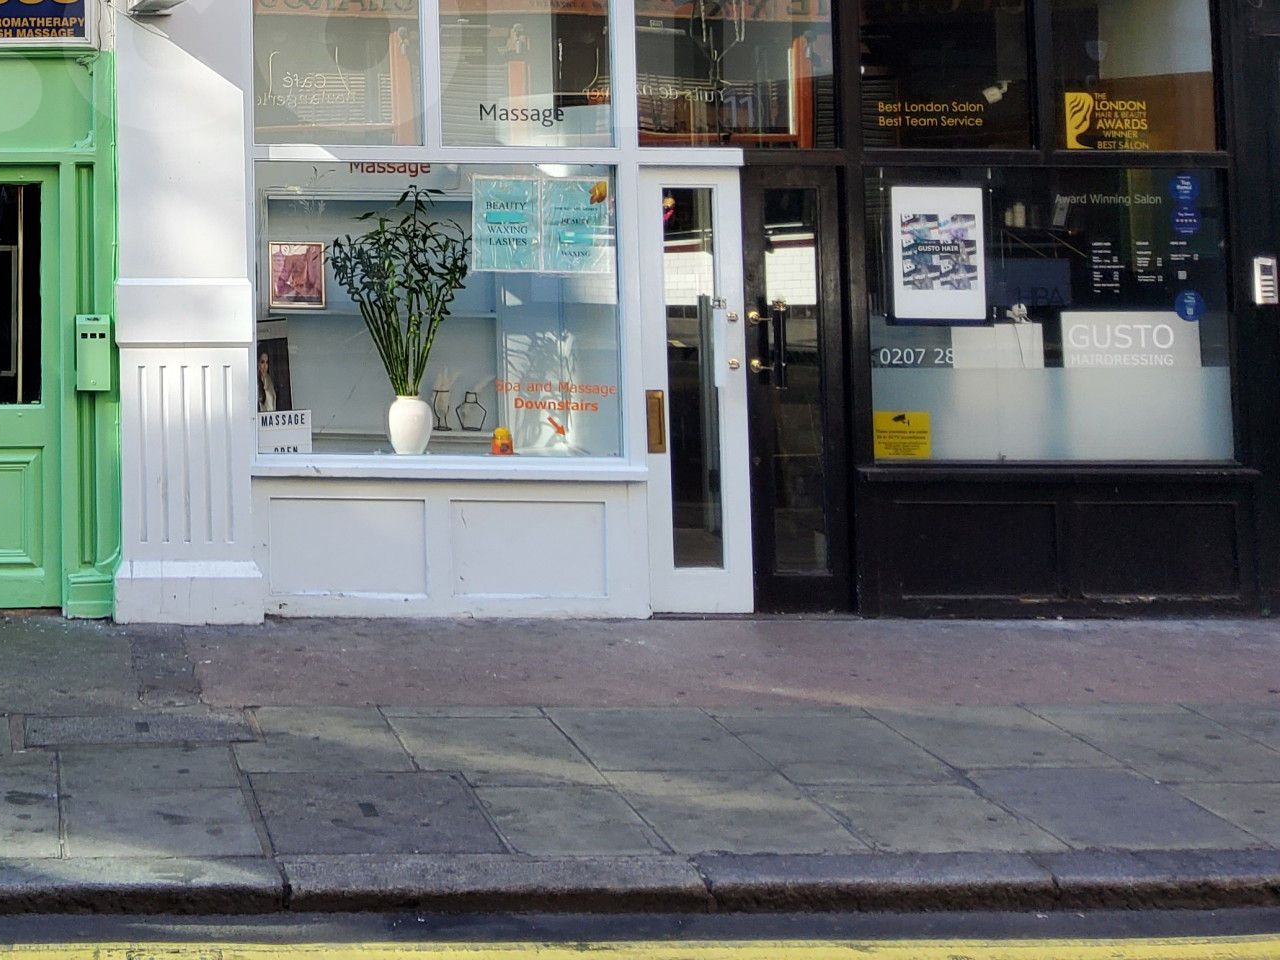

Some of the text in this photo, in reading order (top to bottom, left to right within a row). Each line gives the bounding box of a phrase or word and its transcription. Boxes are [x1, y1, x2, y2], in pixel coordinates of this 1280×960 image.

[16, 28, 75, 38] MASSAGE
[1095, 92, 1107, 100] THE
[878, 101, 984, 112] Best London Salon
[1095, 101, 1146, 111] LONDON
[479, 103, 564, 128] Massage
[878, 116, 983, 127] Best Team Service
[1096, 119, 1148, 130] AWARDS
[1103, 130, 1138, 138] WINNER
[1097, 141, 1149, 150] BEST SALON
[350, 162, 431, 178] Massage
[1055, 193, 1162, 206] Award Winning Salon
[485, 201, 527, 211] BEAUTY
[487, 225, 528, 235] WAXING
[489, 238, 528, 246] LASHES
[1069, 324, 1175, 349] GUSTO
[879, 348, 925, 365] 0207
[1071, 353, 1175, 366] HAIRDRESSING
[495, 378, 618, 397] Spa and Massage
[514, 397, 599, 412] Downstairs
[261, 413, 306, 428] MASSAGE
